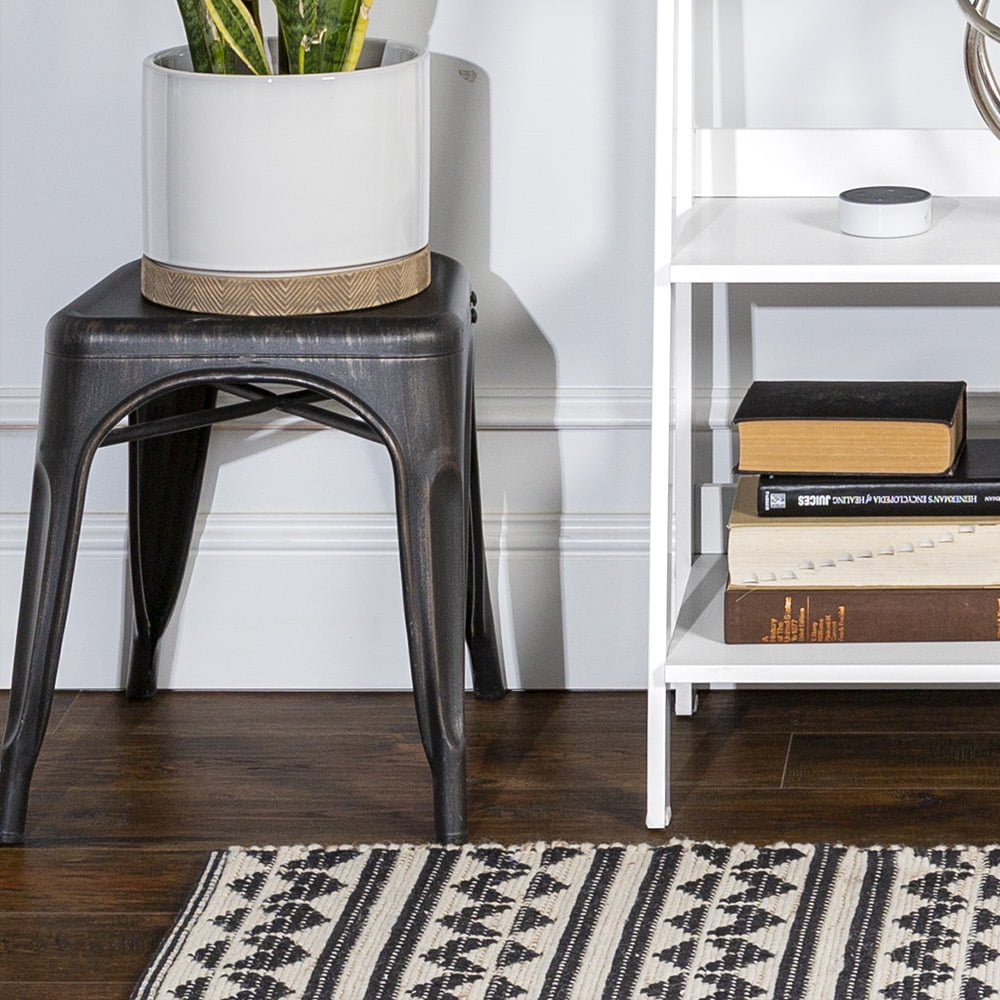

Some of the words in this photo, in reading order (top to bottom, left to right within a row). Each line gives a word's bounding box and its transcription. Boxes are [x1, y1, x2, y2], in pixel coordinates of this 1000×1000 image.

[797, 494, 831, 506] JUICES
[832, 495, 865, 505] HEALING
[865, 493, 873, 505] of
[873, 495, 927, 504] ENCYCLOPEDIA
[928, 494, 977, 504] HEINERMAN'S
